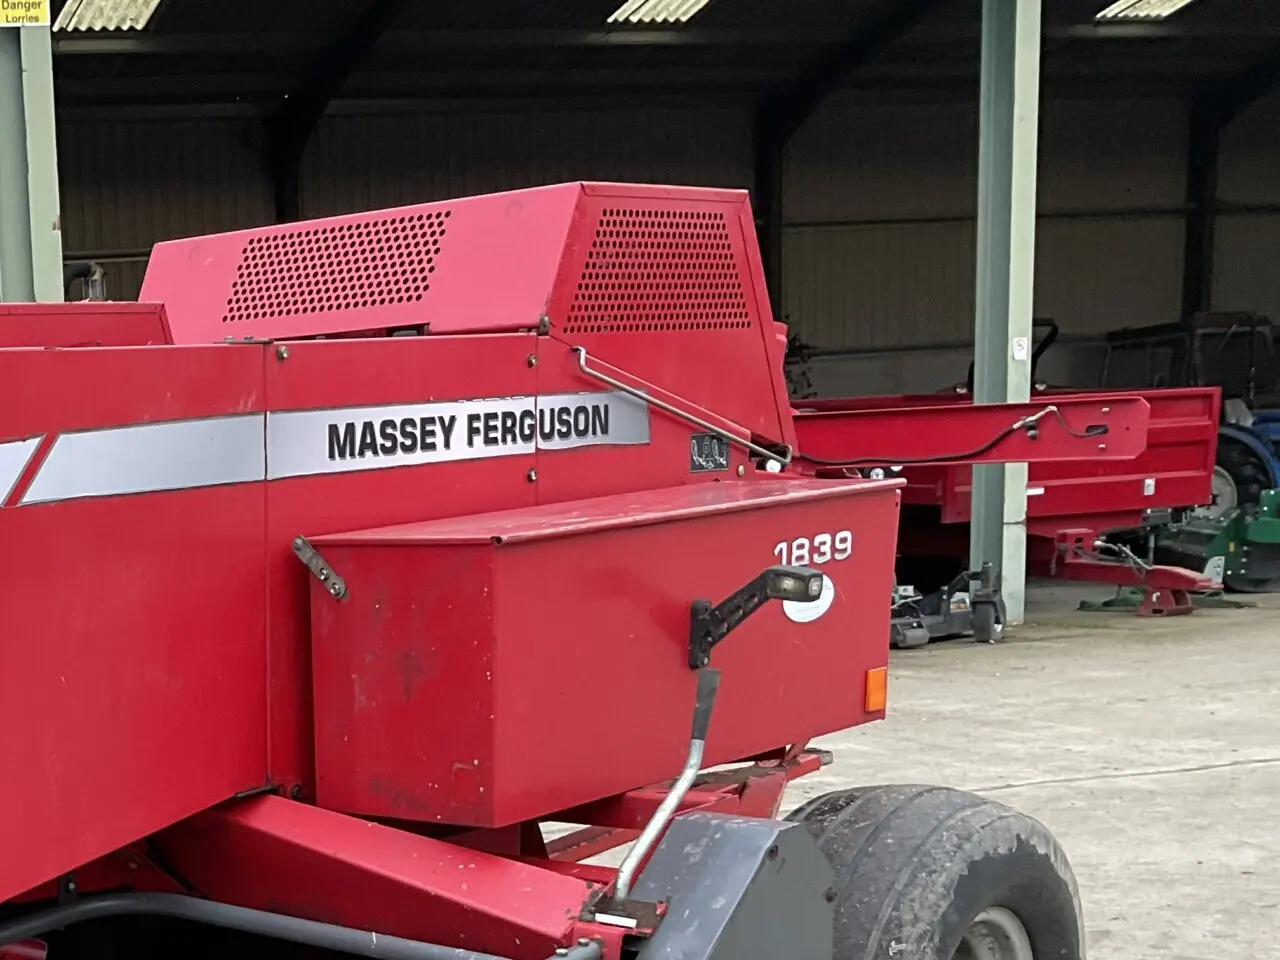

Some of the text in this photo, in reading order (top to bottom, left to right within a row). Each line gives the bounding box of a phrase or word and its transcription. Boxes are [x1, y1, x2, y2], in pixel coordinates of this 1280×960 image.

[1, 0, 42, 12] Danger
[5, 14, 40, 23] Lorries
[327, 403, 610, 461] MASSEY FERGUSON
[773, 530, 852, 567] 1839
